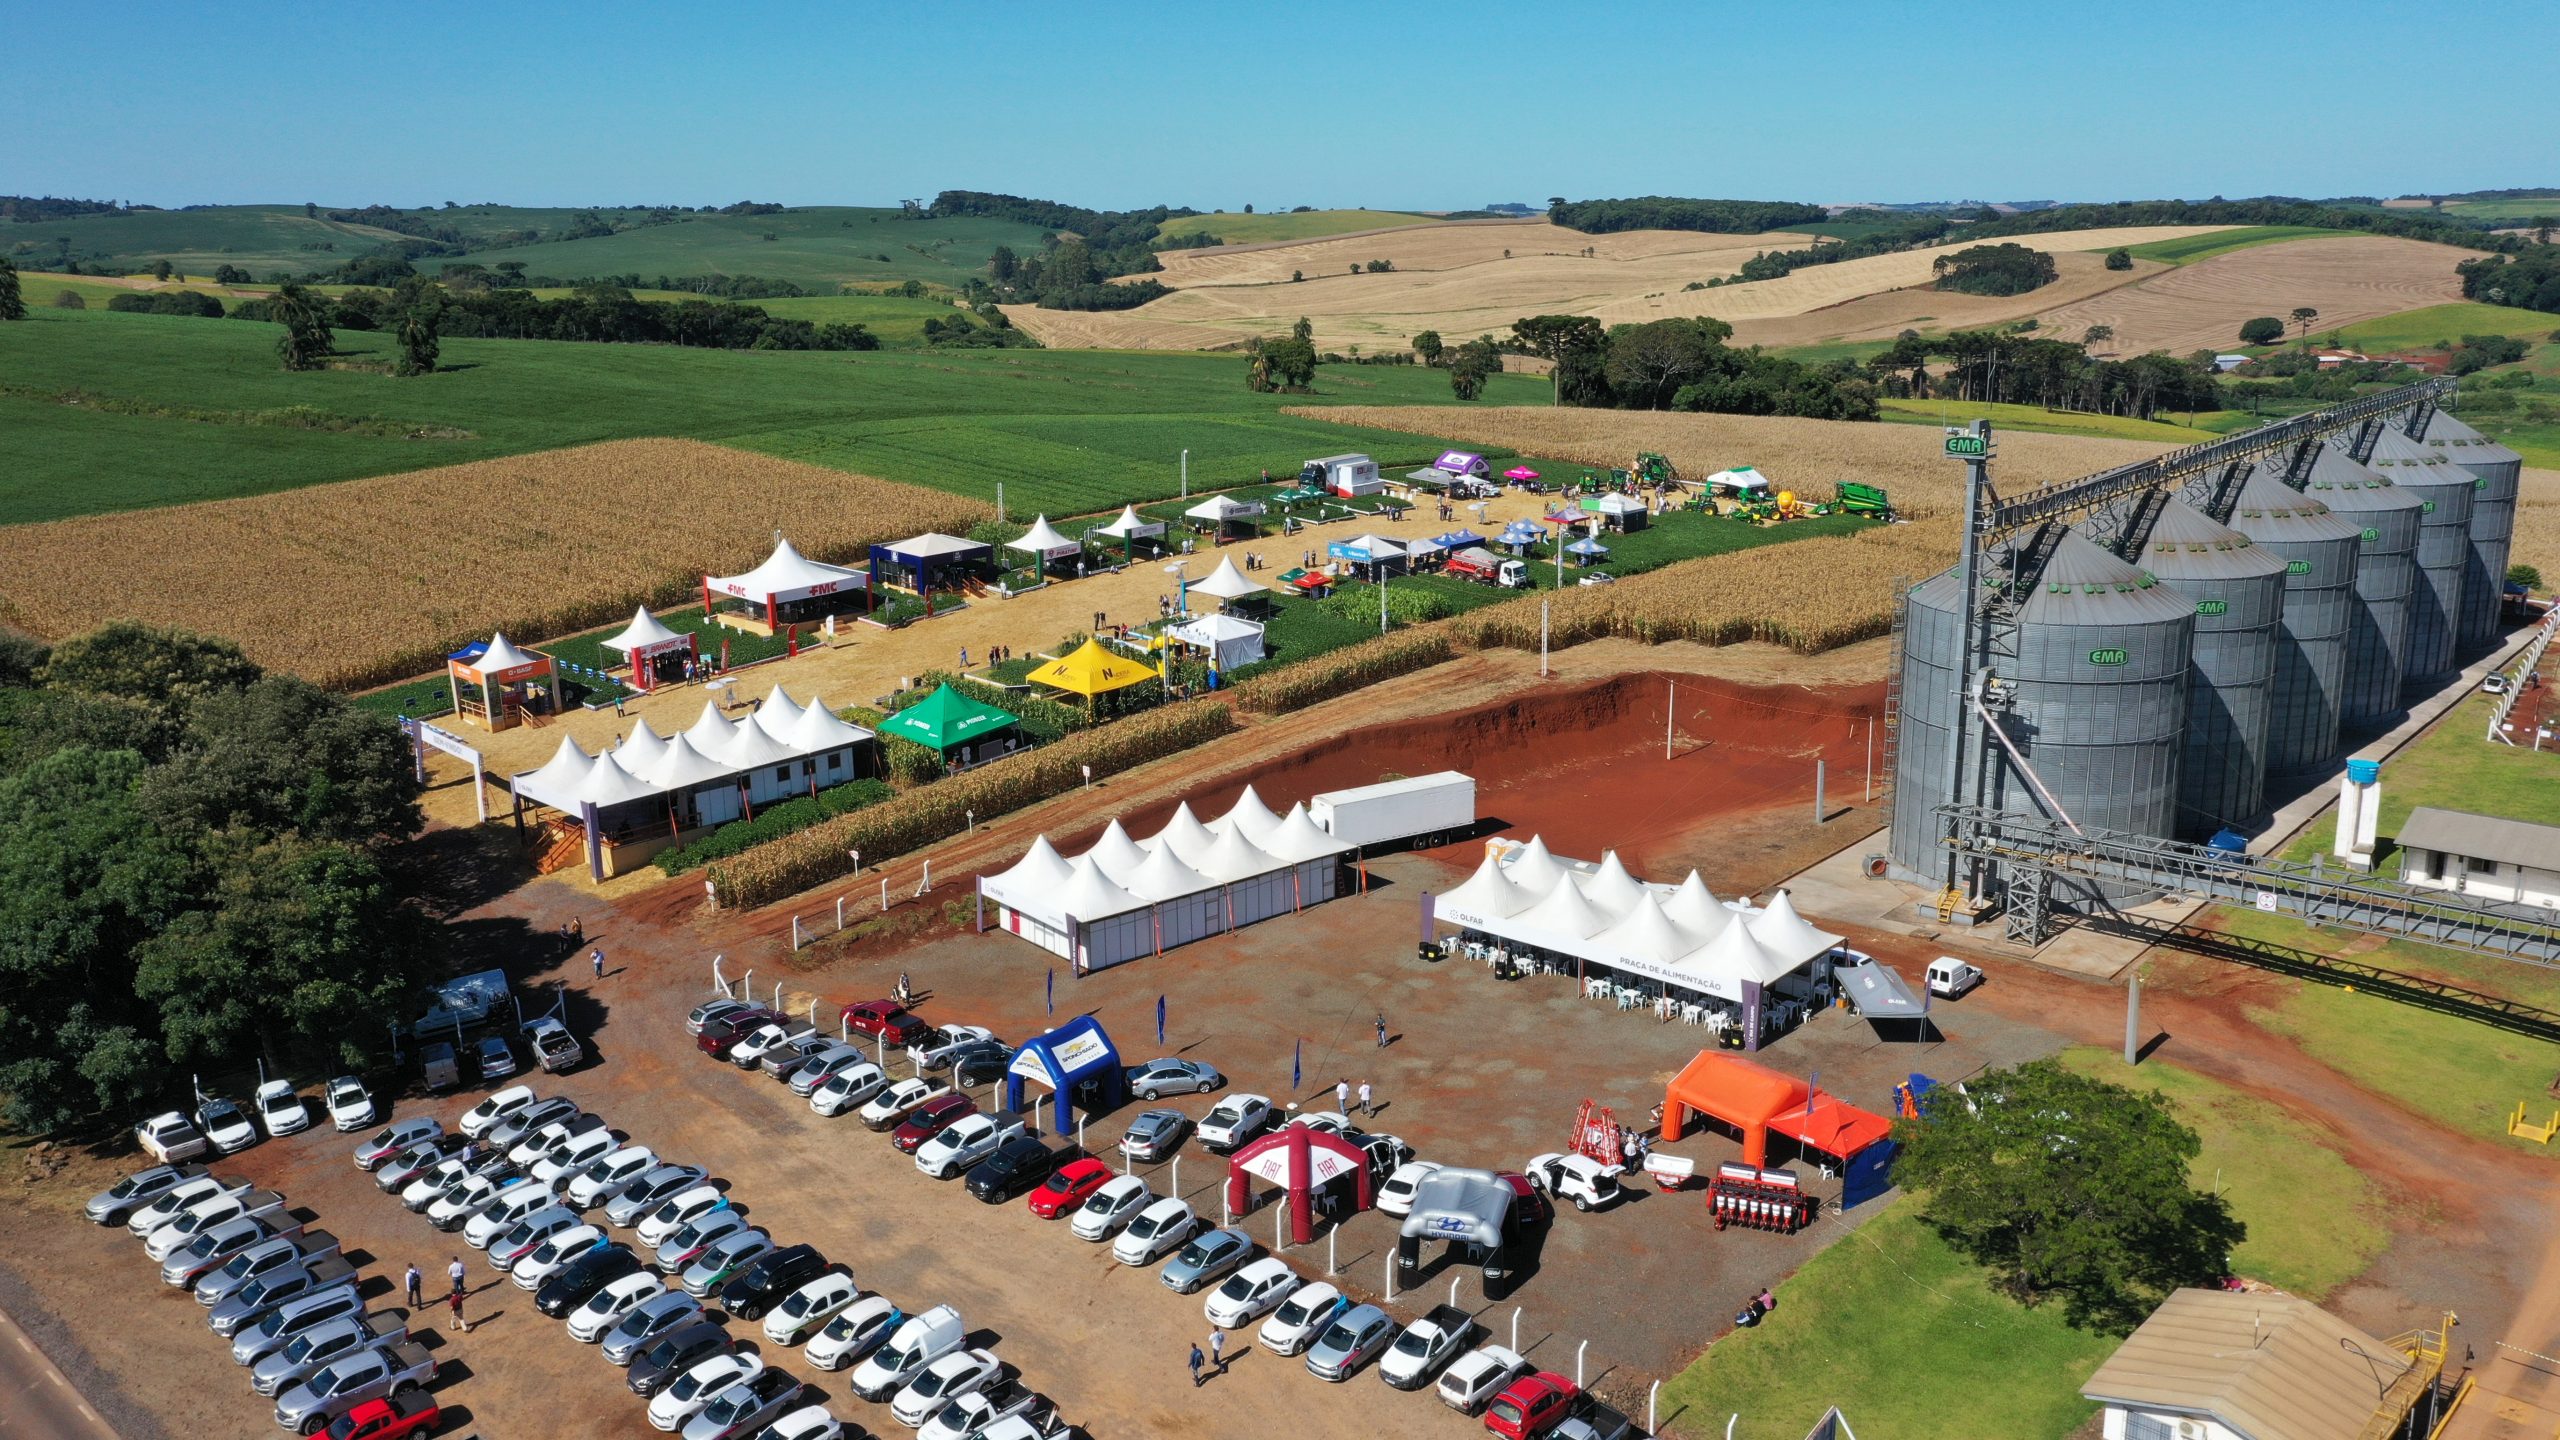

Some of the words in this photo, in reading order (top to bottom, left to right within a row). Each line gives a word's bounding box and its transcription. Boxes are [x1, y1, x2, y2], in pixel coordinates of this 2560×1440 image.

[1949, 439, 1981, 452] EMA
[2288, 562, 2307, 574] MA
[727, 583, 746, 597] FMC
[809, 582, 838, 596] FMC
[2197, 602, 2225, 613] EMA
[650, 640, 678, 654] BRANDT
[2092, 651, 2125, 663] EMA
[1459, 913, 1484, 926] OLFAR
[1620, 956, 1647, 970] PRAÇA
[1649, 965, 1660, 974] DE
[1662, 968, 1722, 991] ALIMENTAÇÃO
[1260, 1159, 1282, 1181] FIAT
[1317, 1157, 1340, 1179] FIAT
[1431, 1231, 1470, 1241] HYUNDAI
